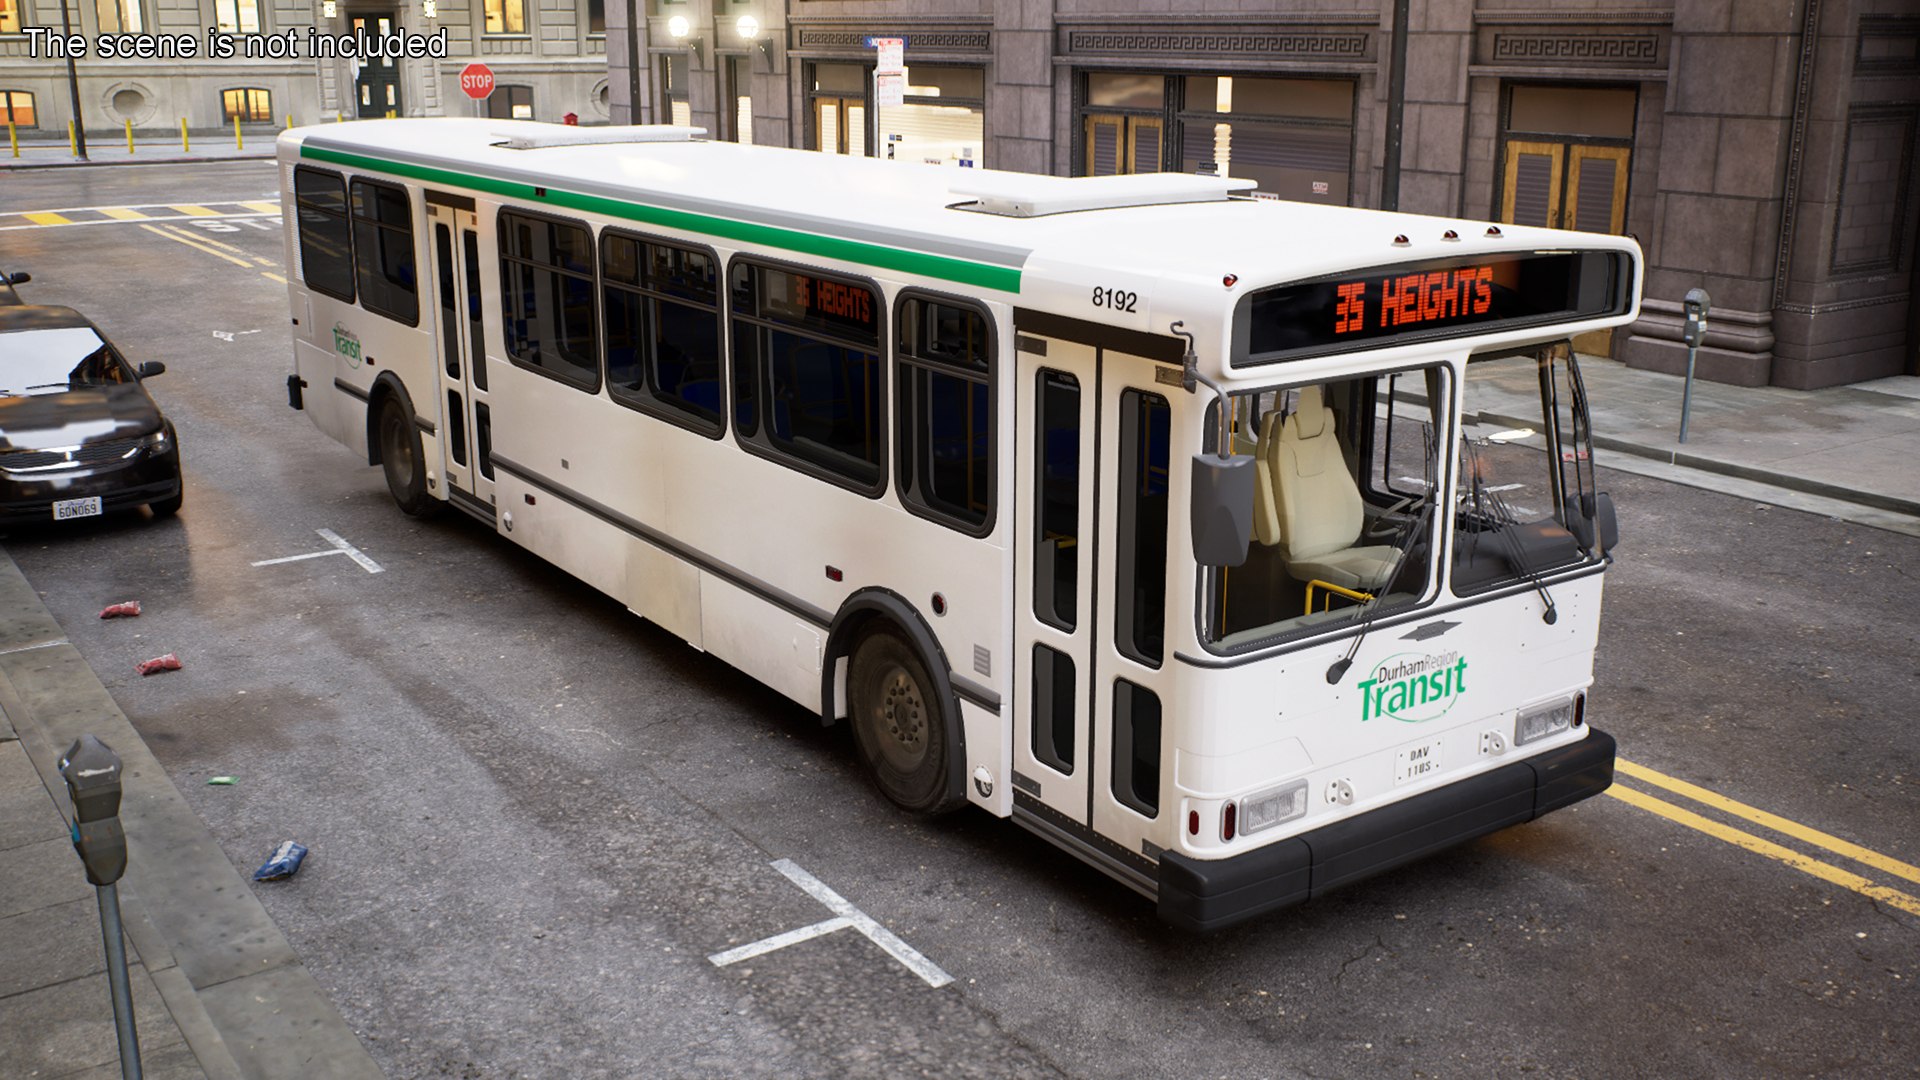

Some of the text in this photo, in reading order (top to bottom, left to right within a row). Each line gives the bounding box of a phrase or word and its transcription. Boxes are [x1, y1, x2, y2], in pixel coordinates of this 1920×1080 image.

[463, 75, 492, 88] STOP
[817, 279, 870, 323] HEIGHTS
[1092, 286, 1137, 314] 8192
[1335, 266, 1494, 334] 35 HEIGHTS
[1357, 655, 1468, 721] Transit
